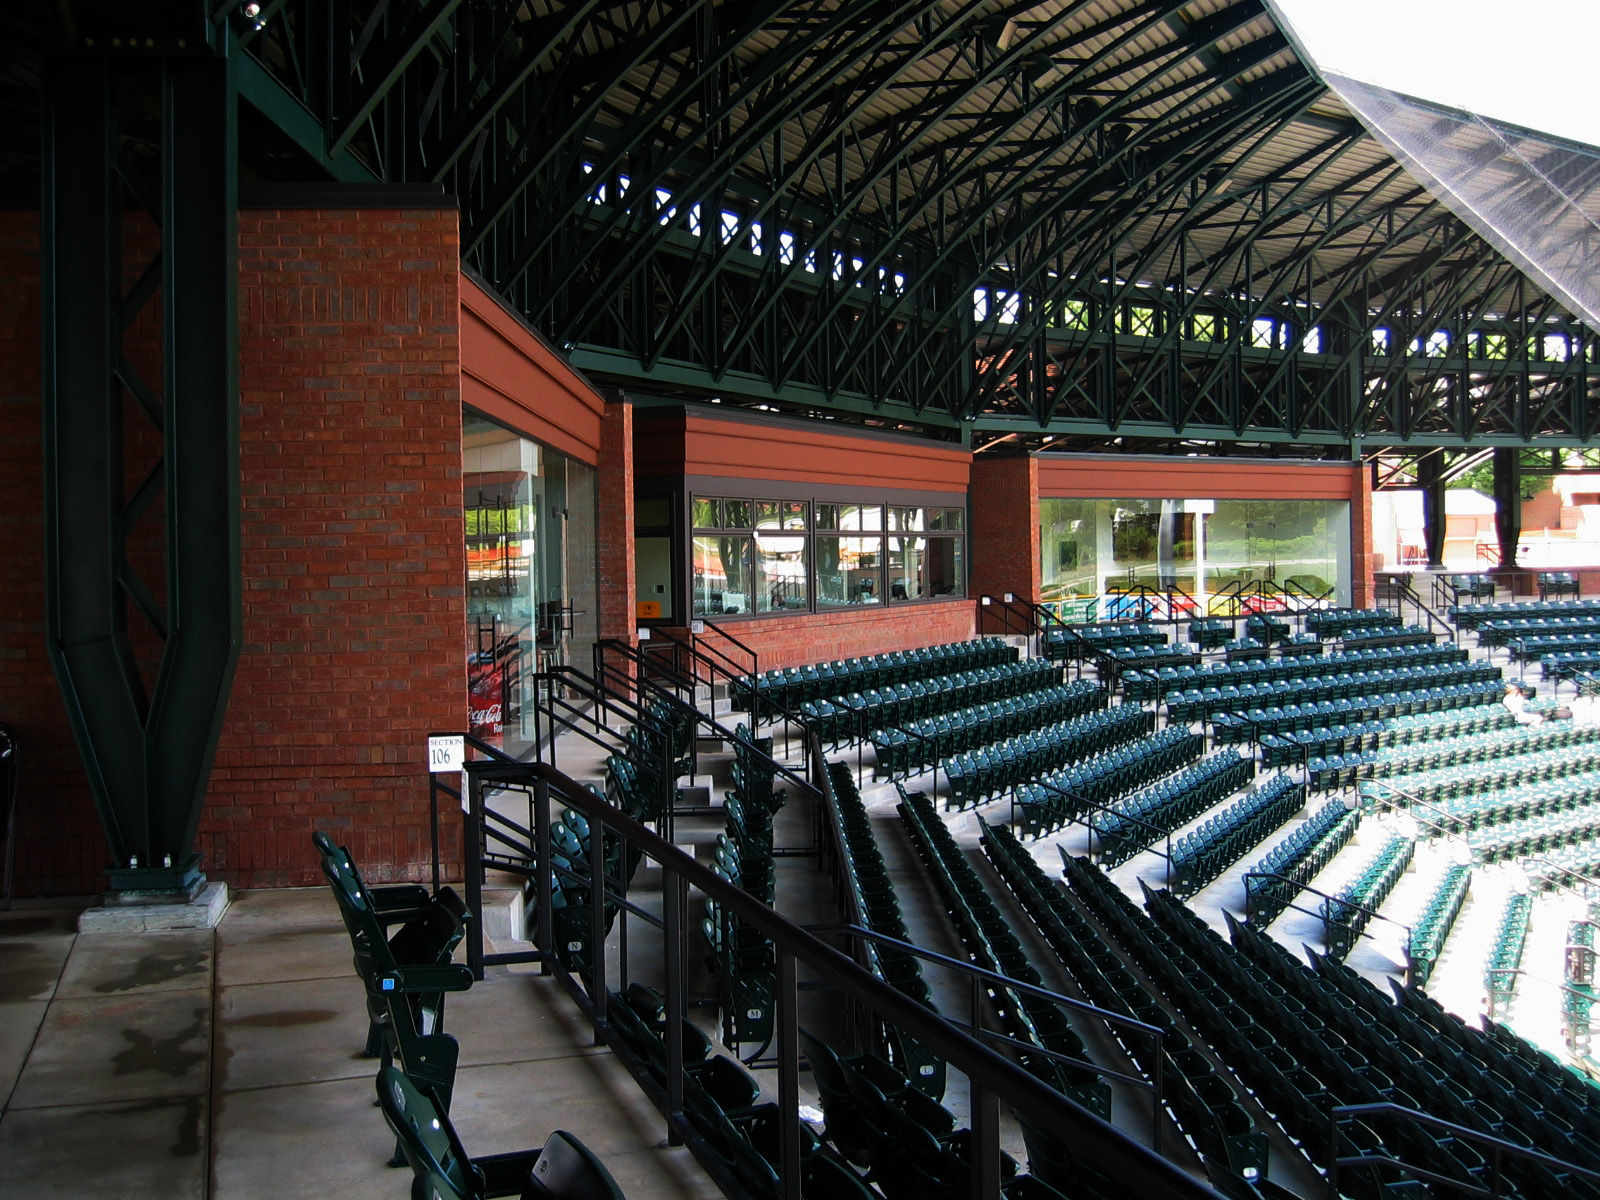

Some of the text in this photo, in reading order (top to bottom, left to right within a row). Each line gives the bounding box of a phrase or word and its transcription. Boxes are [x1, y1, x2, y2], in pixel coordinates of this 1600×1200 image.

[430, 738, 463, 746] SECTION
[432, 748, 451, 765] 106
[750, 1010, 759, 1018] M
